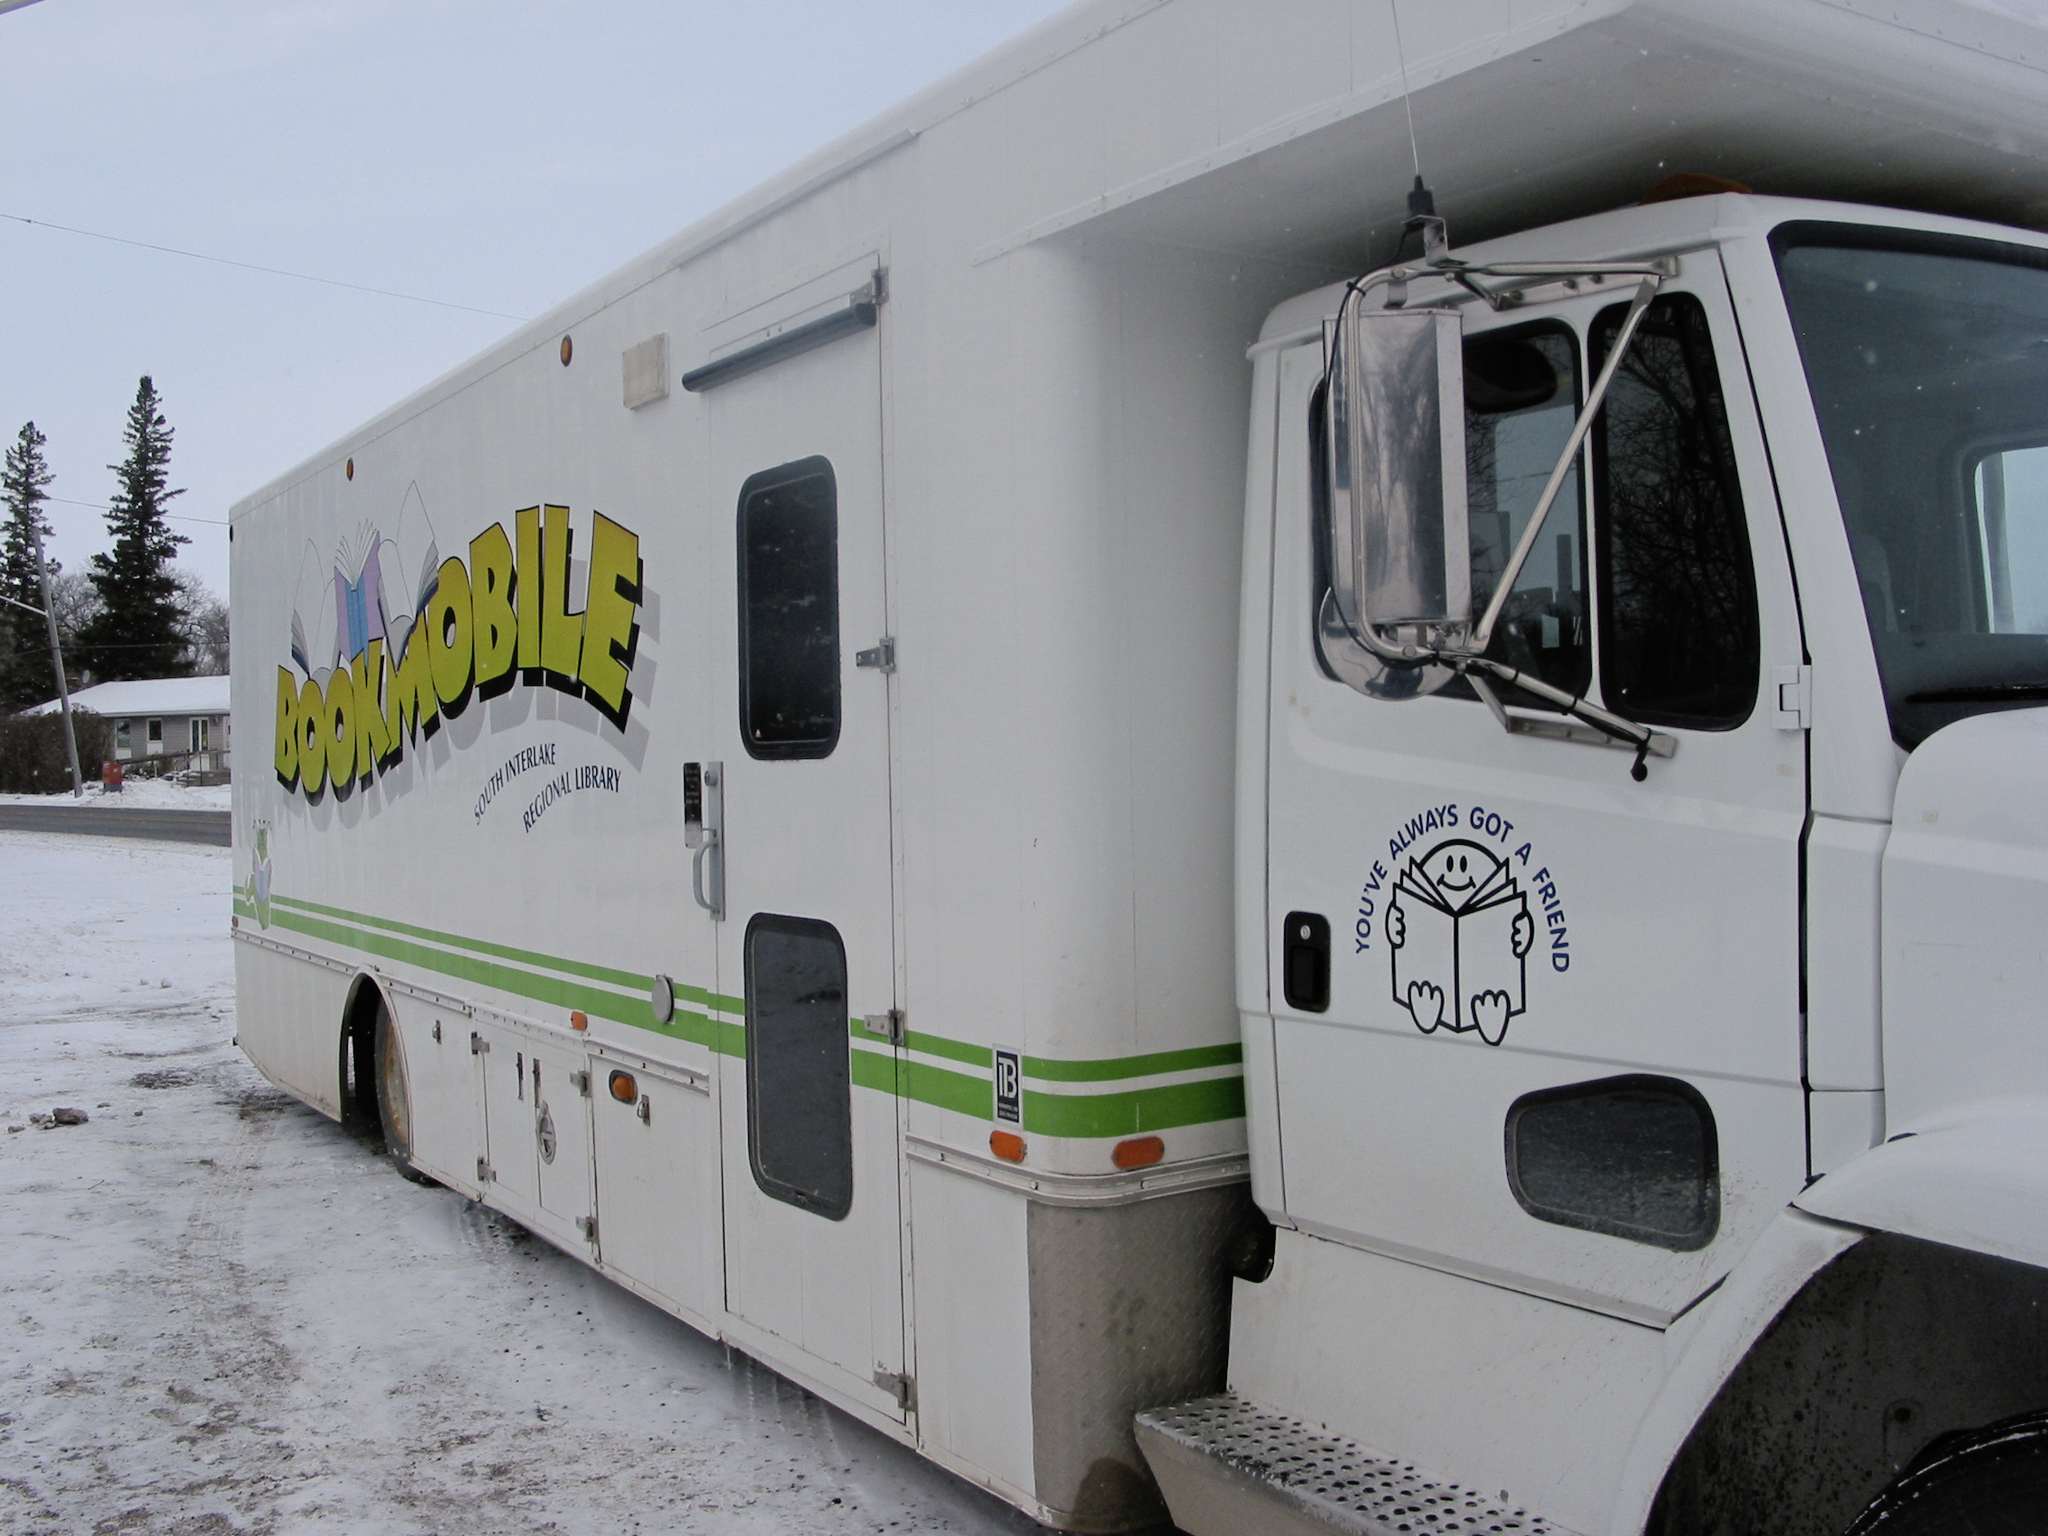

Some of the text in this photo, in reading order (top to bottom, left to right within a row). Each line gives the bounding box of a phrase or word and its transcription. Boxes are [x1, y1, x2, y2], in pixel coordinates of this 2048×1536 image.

[274, 503, 643, 806] BOOKMOBILE
[474, 743, 556, 826] SOUTH INTERLAKE
[522, 765, 621, 833] REGIONAL LIBRARY
[1355, 803, 1570, 973] YOU'VE ALWAYS GOT A FRIEND
